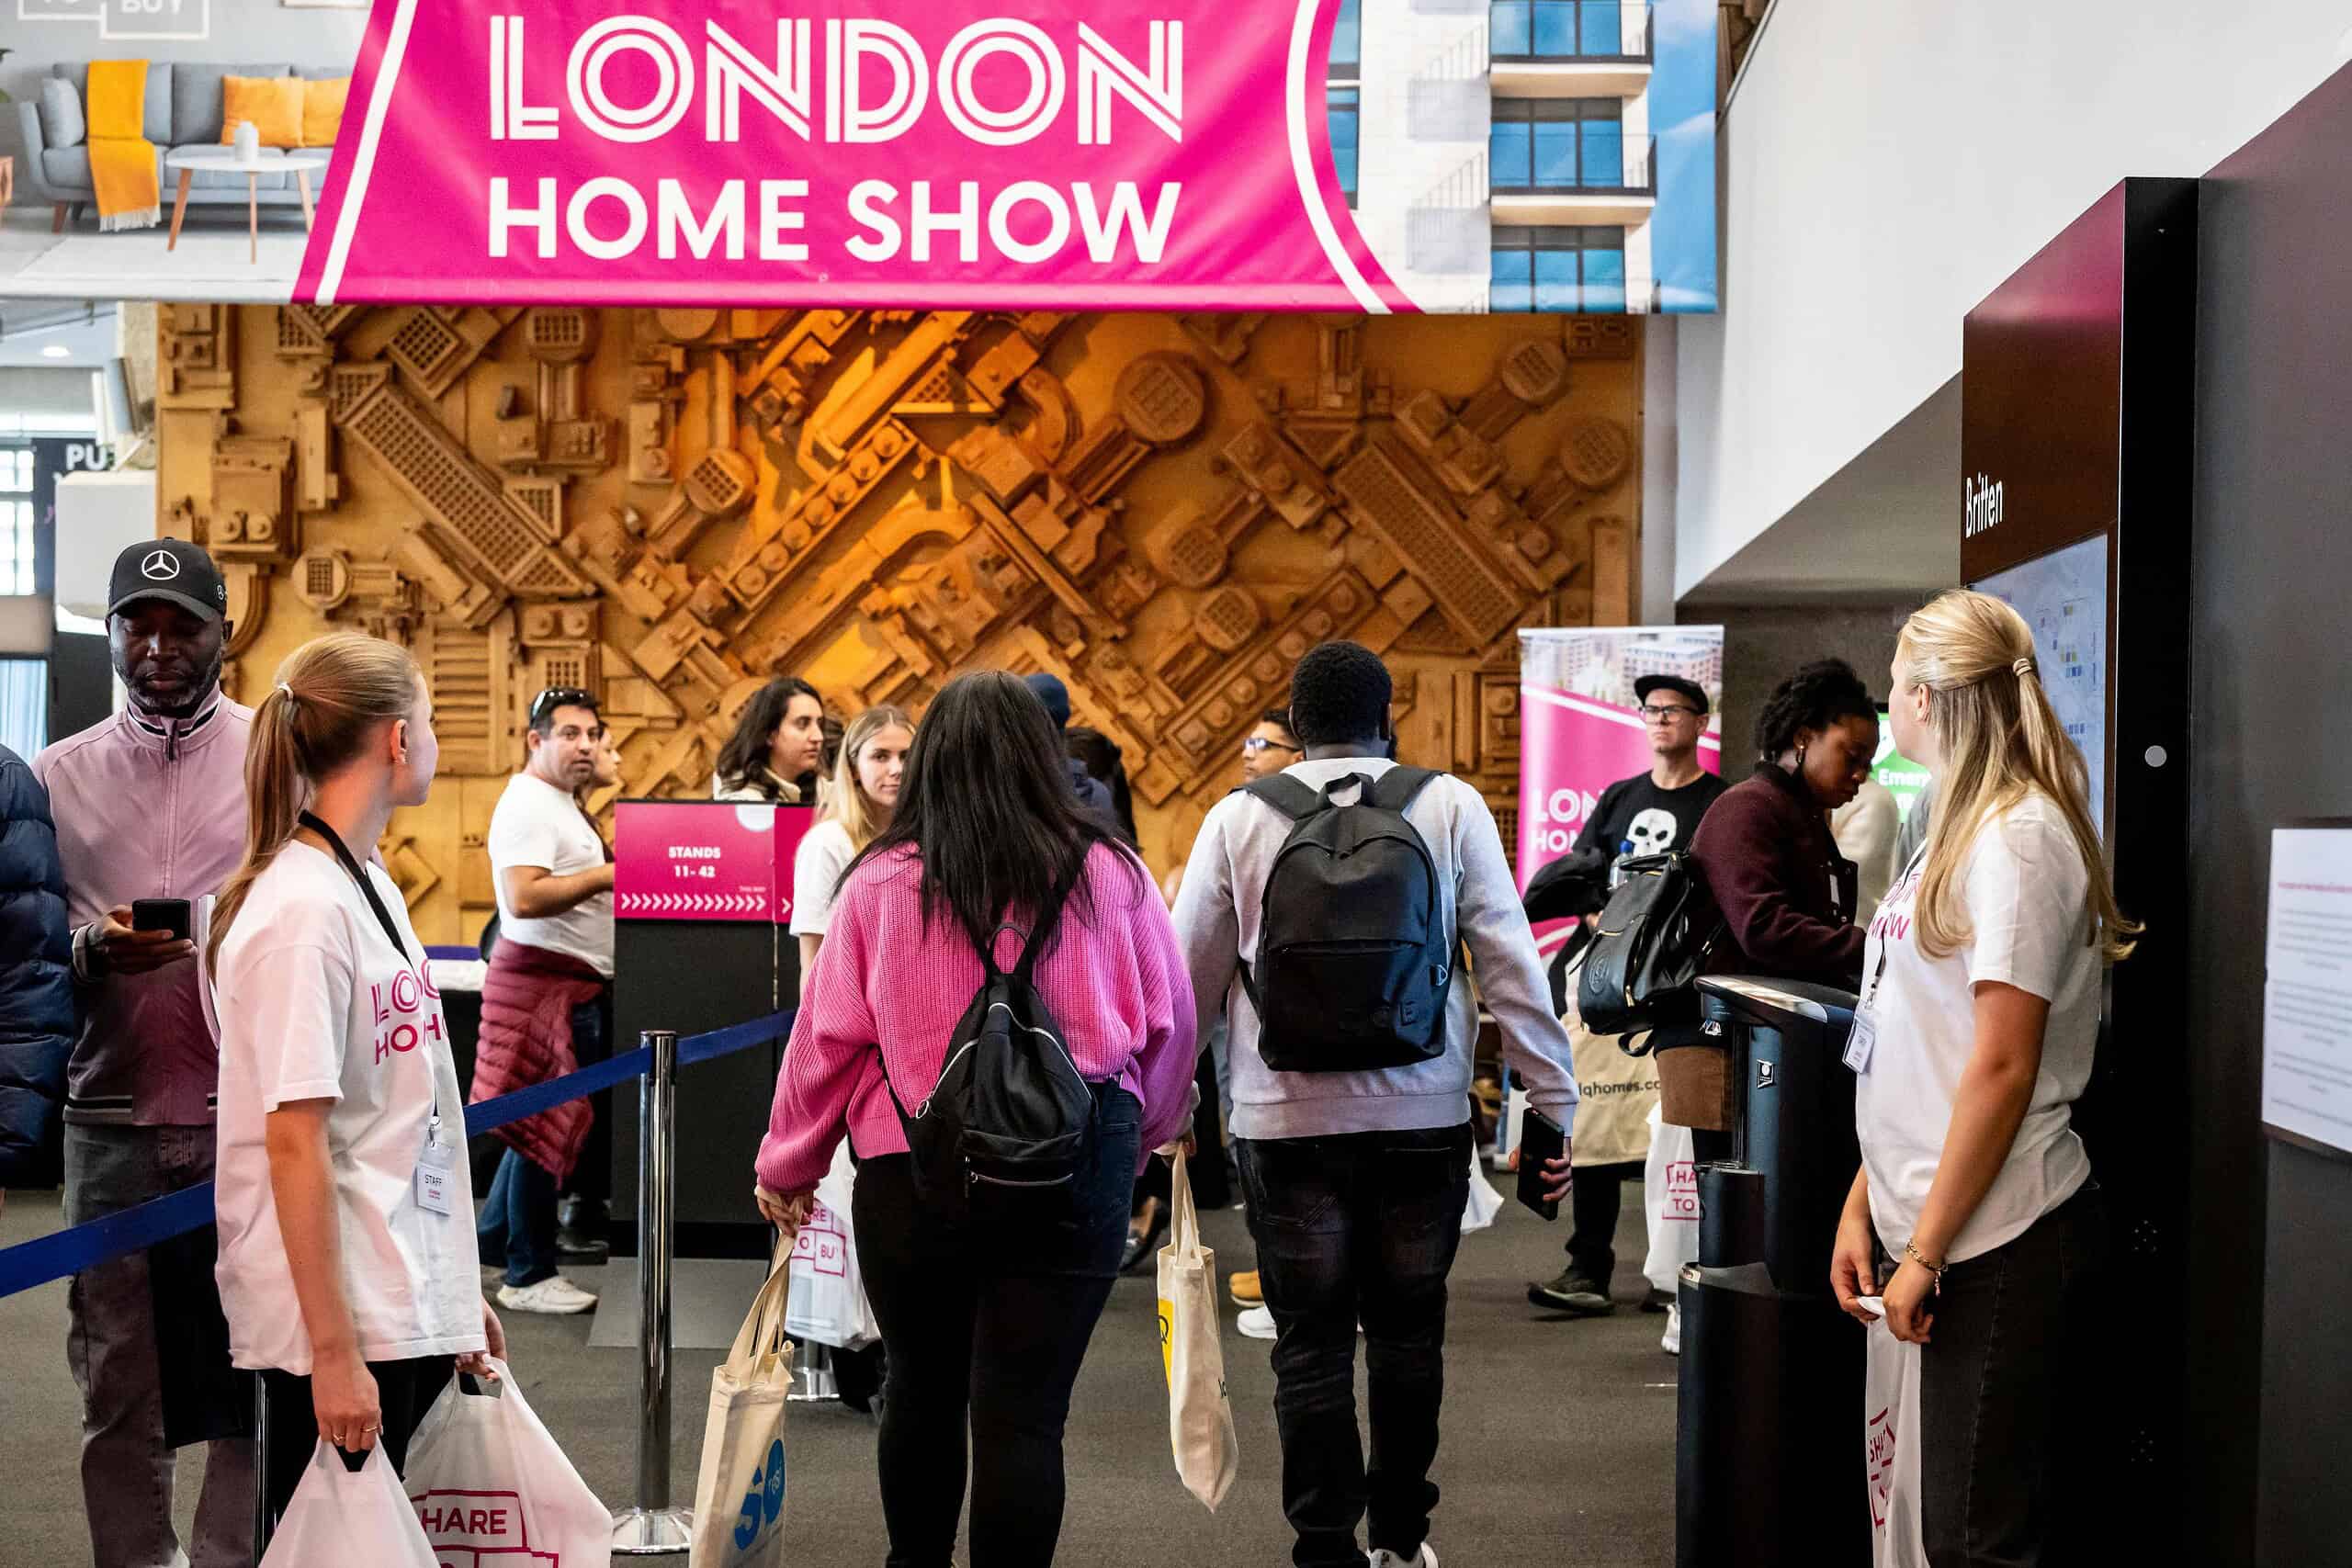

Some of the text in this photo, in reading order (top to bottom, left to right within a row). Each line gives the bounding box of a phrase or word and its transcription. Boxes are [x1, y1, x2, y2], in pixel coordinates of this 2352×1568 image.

[490, 16, 1183, 146] LONDON
[488, 177, 1182, 264] HOME SHOW
[1965, 470, 2003, 539] Britten
[668, 845, 721, 859] STANDS
[1672, 1198, 1695, 1212] TO
